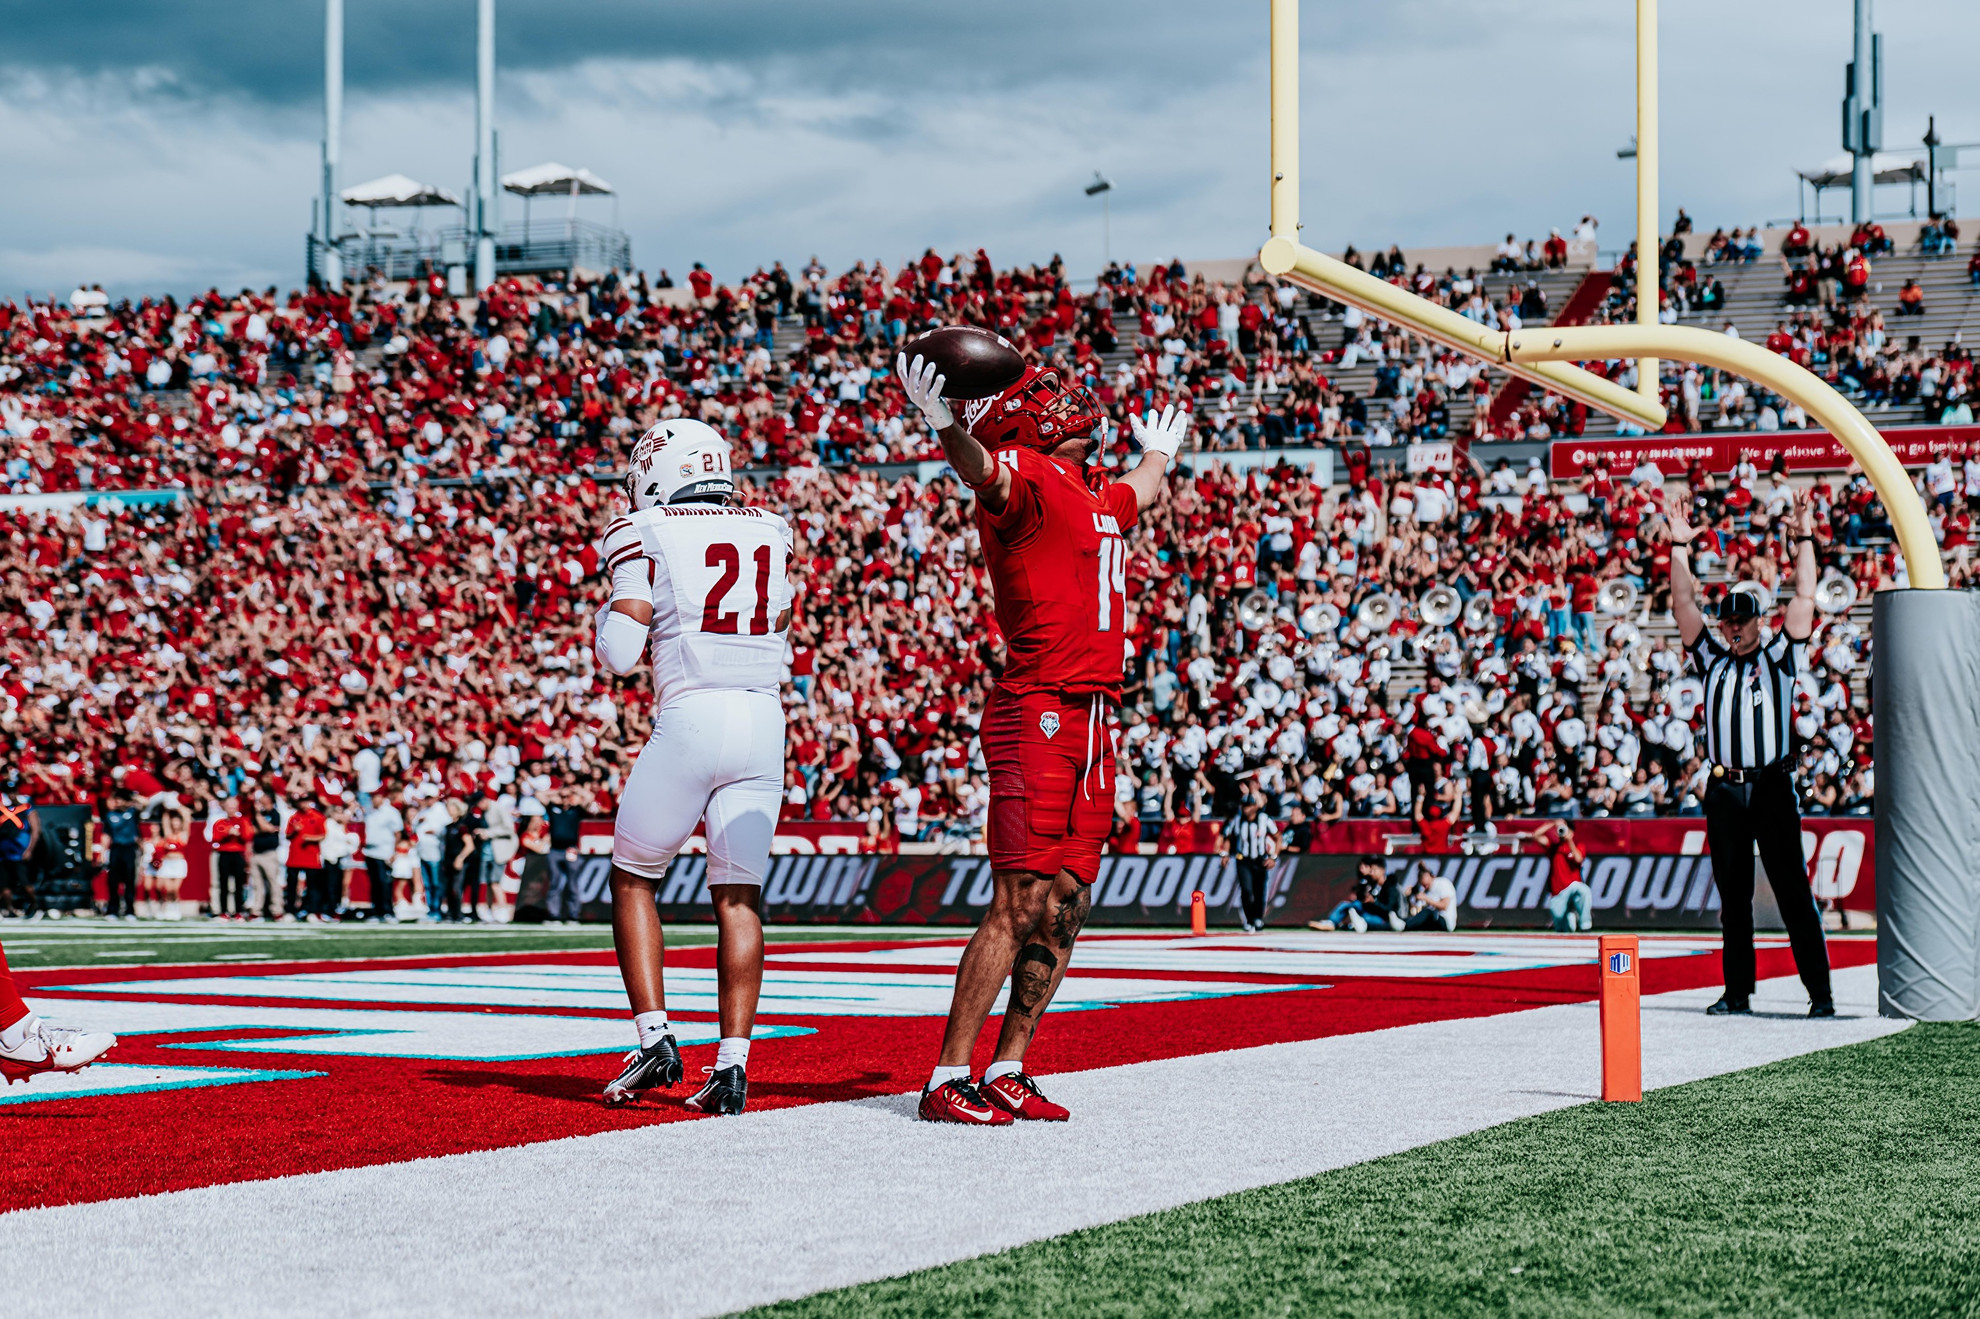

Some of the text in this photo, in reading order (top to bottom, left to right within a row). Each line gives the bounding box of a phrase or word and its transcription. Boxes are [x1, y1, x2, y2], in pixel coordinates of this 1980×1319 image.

[1889, 443, 1906, 454] an
[702, 453, 724, 473] 21
[993, 450, 1019, 472] 4
[700, 542, 771, 636] 21
[1098, 537, 1128, 633] 14
